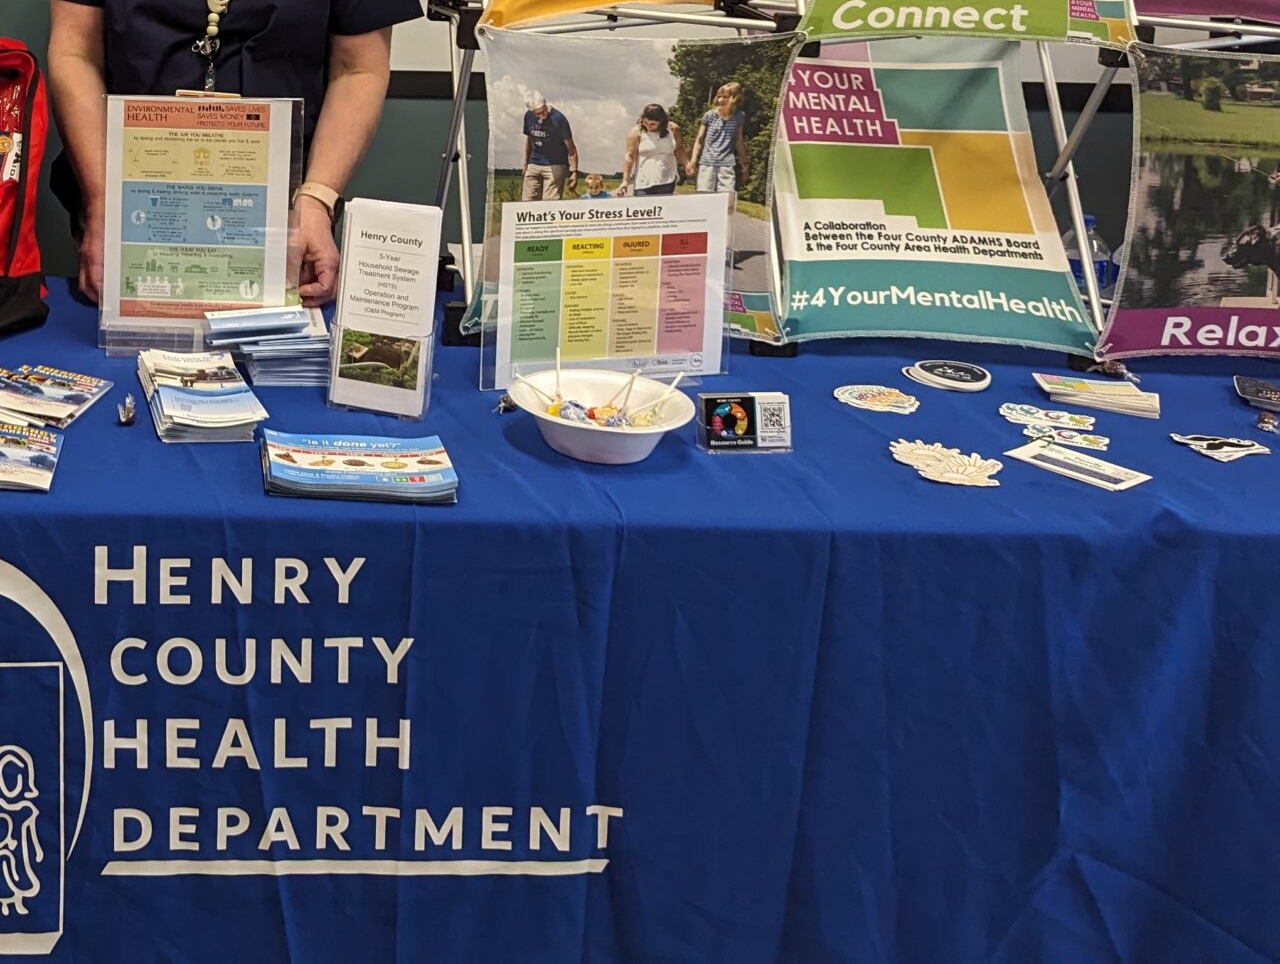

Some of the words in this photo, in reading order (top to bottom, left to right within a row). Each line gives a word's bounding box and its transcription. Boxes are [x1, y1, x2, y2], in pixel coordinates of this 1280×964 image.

[127, 105, 195, 114] ENVIRONMENTAL
[788, 91, 876, 113] MENTAL
[127, 113, 168, 122] HEALTH
[793, 116, 883, 137] HEALTH
[516, 210, 556, 223] What's
[558, 209, 587, 221] Your
[588, 208, 623, 219] Stress
[626, 206, 663, 218] Level?
[803, 221, 812, 231] A
[814, 221, 886, 232] Collaboration
[360, 230, 388, 243] Henry
[389, 234, 424, 248] County
[572, 242, 605, 251] REACTING
[623, 240, 651, 249] INJURED
[805, 231, 853, 241] Between
[855, 231, 874, 241] the
[877, 232, 902, 241] Four
[905, 233, 948, 245] County
[952, 235, 1003, 247] ADAMHS
[1006, 238, 1040, 250] Board
[527, 245, 549, 253] READY
[806, 242, 814, 252] &
[816, 242, 834, 252] the
[835, 242, 859, 252] Four
[860, 242, 901, 253] County
[904, 243, 932, 253] Area
[934, 244, 971, 255] Health
[972, 247, 1044, 261] Departments
[379, 253, 401, 263] 5-Year
[358, 260, 392, 272] Household
[394, 265, 420, 276] Sewage
[358, 269, 391, 279] Treatment
[391, 272, 416, 284] System
[377, 281, 398, 291] (HSTS)
[349, 295, 390, 307] Maintenance
[391, 300, 419, 312] Program
[364, 289, 394, 300] Operation
[396, 293, 409, 302] and
[790, 284, 1085, 324] #4YourMentalHealth
[364, 307, 380, 315] (O&M
[380, 309, 406, 320] Program)
[333, 440, 368, 448] done
[92, 545, 367, 605] HENRY
[110, 636, 415, 687] COUNTY
[102, 717, 411, 770] HEALTH
[113, 804, 624, 852] DEPARTMENT
